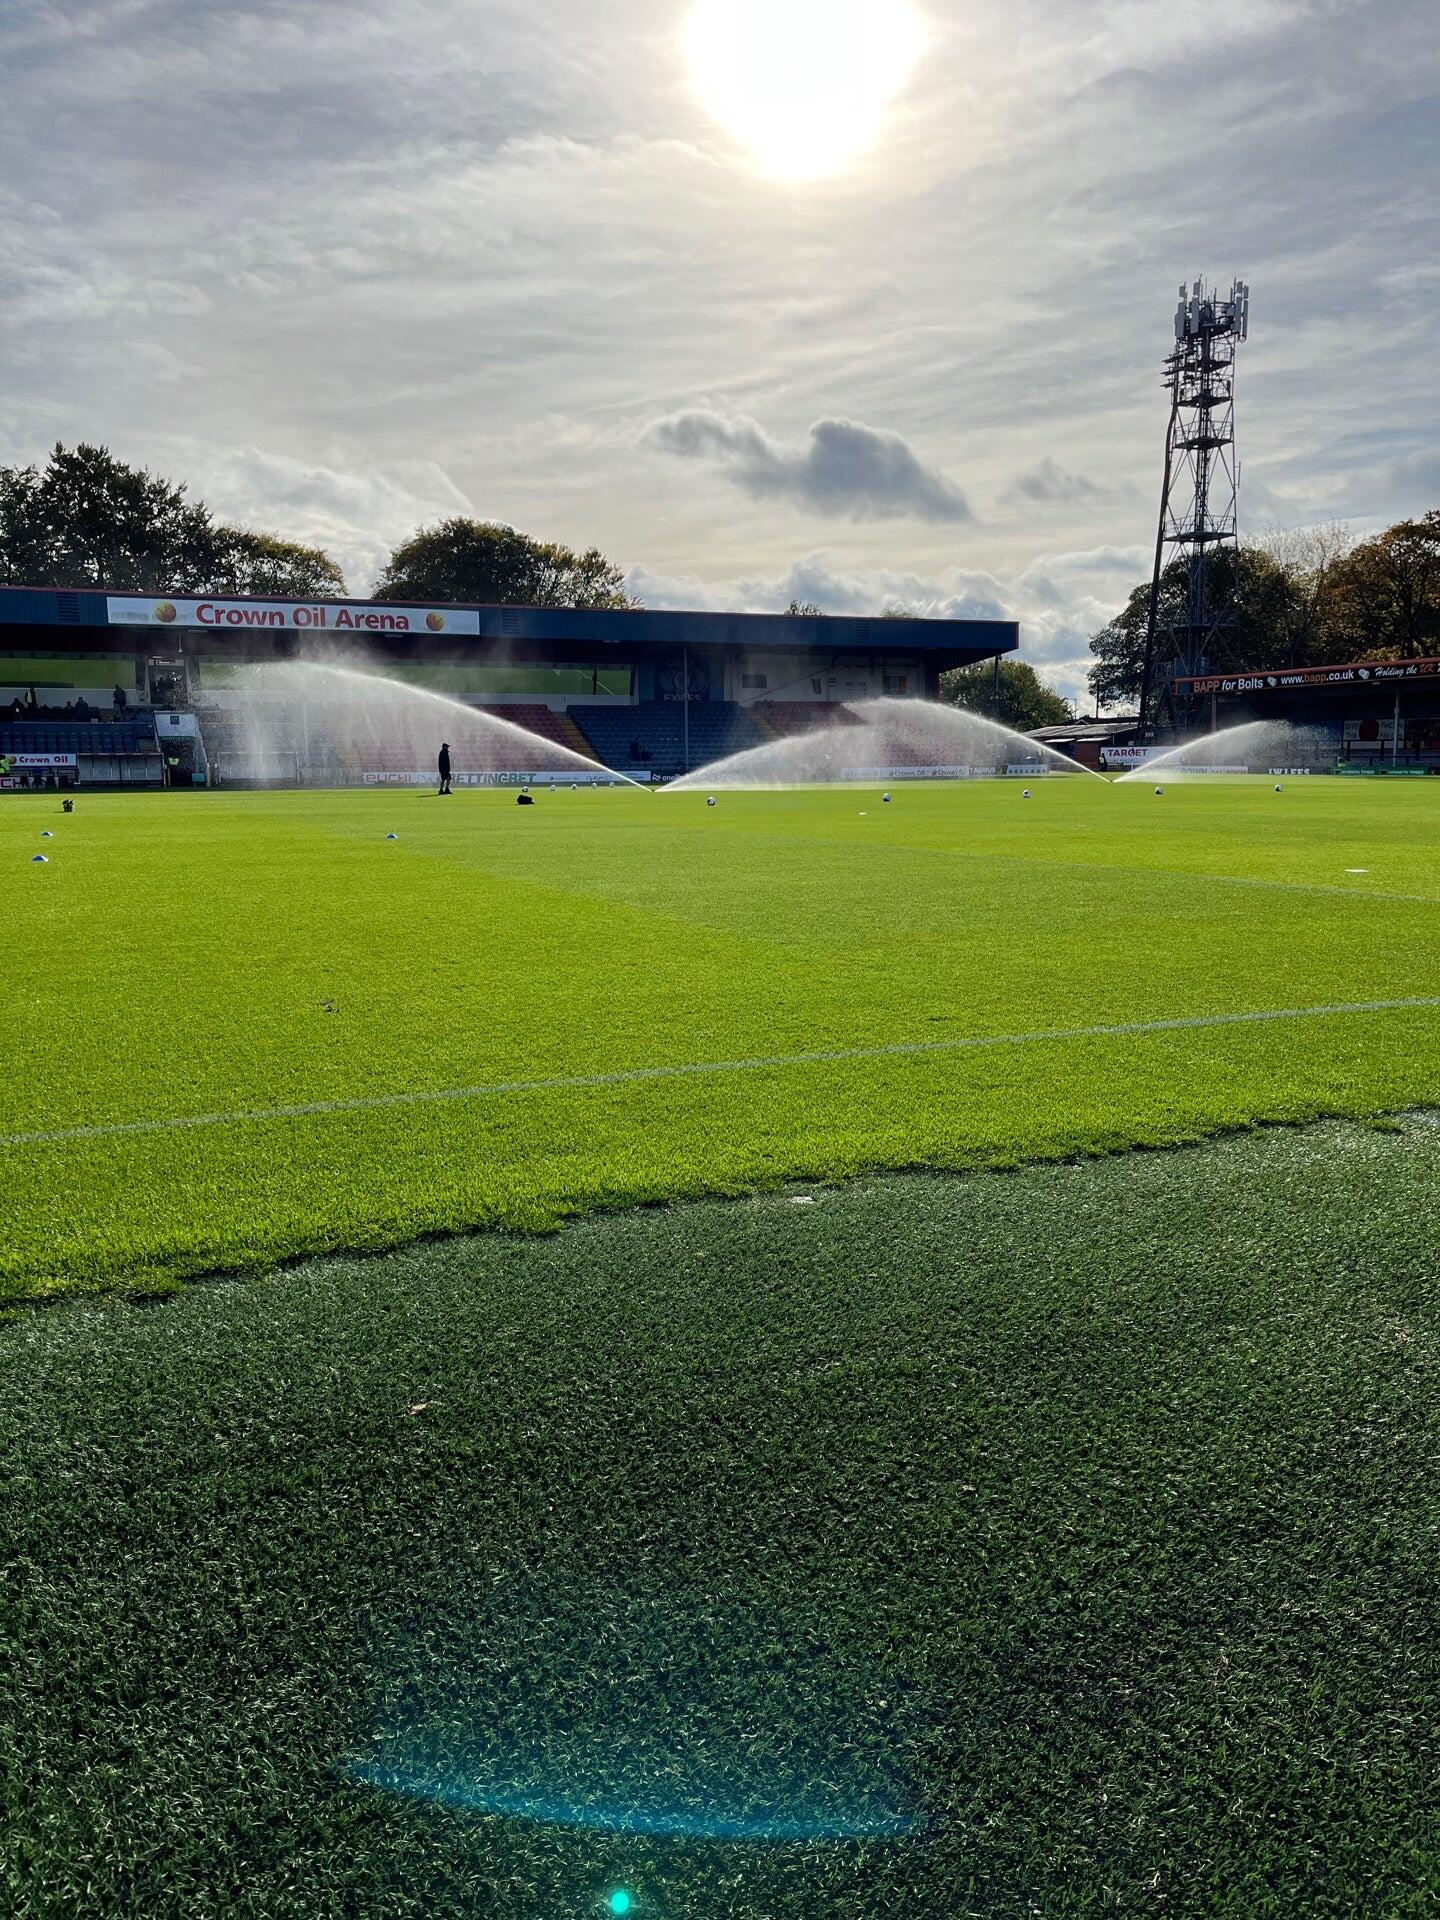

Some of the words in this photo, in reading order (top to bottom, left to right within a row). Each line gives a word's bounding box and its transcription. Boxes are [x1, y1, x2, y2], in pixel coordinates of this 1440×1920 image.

[196, 603, 285, 626] Crown
[292, 607, 326, 628] Oil
[335, 608, 410, 631] Arena
[1281, 670, 1354, 685] www.bapp.co.uk
[1374, 666, 1404, 678] Holding
[1406, 664, 1418, 674] the
[1194, 681, 1220, 692] BAPP
[1222, 680, 1236, 690] for
[1238, 678, 1263, 690] Bolts
[1107, 747, 1148, 757] TARGET
